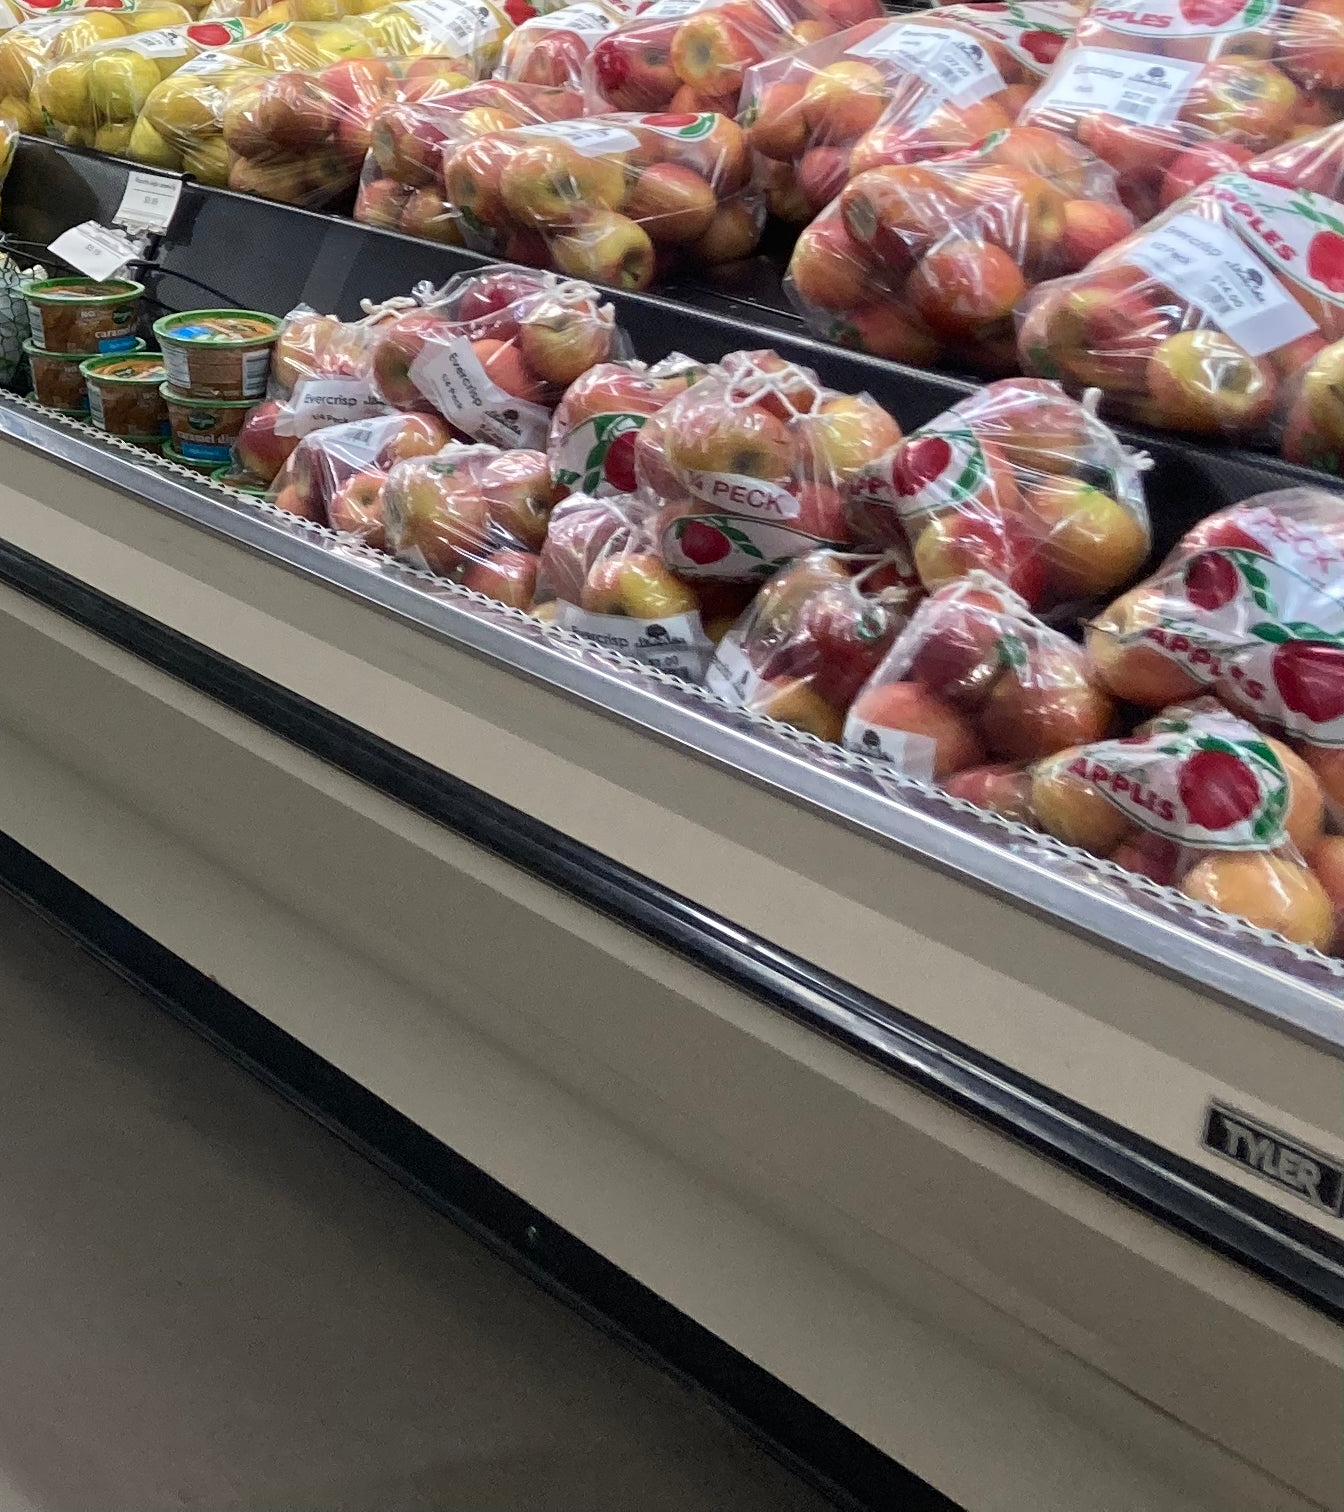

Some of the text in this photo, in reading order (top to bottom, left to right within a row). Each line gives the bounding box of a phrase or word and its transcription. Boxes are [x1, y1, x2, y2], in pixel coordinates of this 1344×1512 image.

[303, 392, 358, 408] Evercrisp
[448, 351, 483, 407] Evercrisp
[712, 479, 783, 515] PECK
[1067, 757, 1175, 822] APPLES
[1222, 1116, 1324, 1205] TYLER
